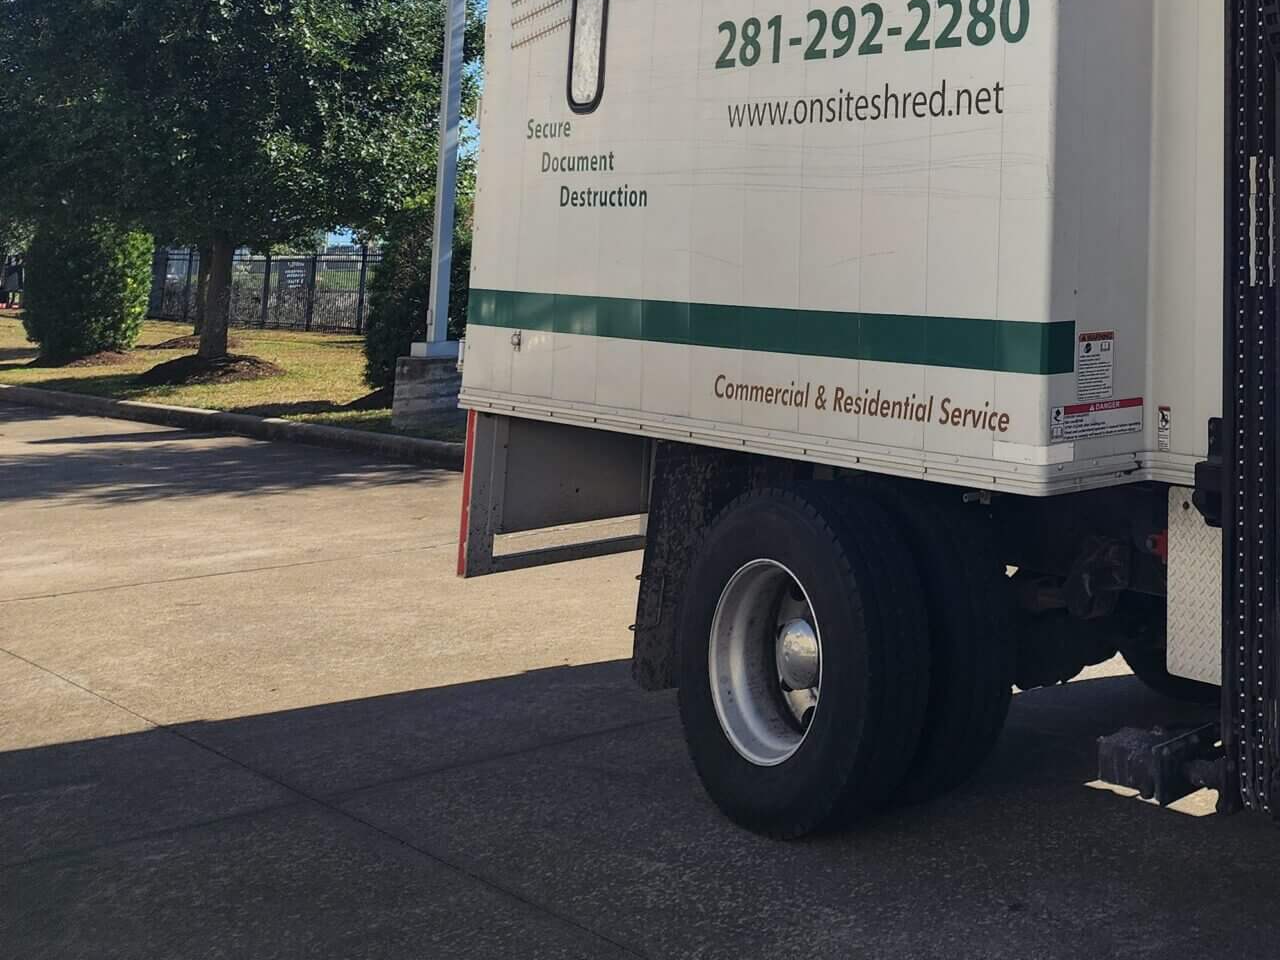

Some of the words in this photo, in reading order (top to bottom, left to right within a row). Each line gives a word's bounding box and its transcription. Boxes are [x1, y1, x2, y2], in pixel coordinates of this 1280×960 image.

[727, 79, 1004, 128] www.onsiteshred.net
[526, 119, 572, 141] Secure
[541, 151, 614, 174] Document
[559, 185, 648, 209] Destruction
[714, 374, 809, 409] Commercial
[813, 385, 827, 410] &
[833, 388, 934, 422] Residential
[939, 398, 1010, 433] Service
[1095, 401, 1121, 410] DANGER
